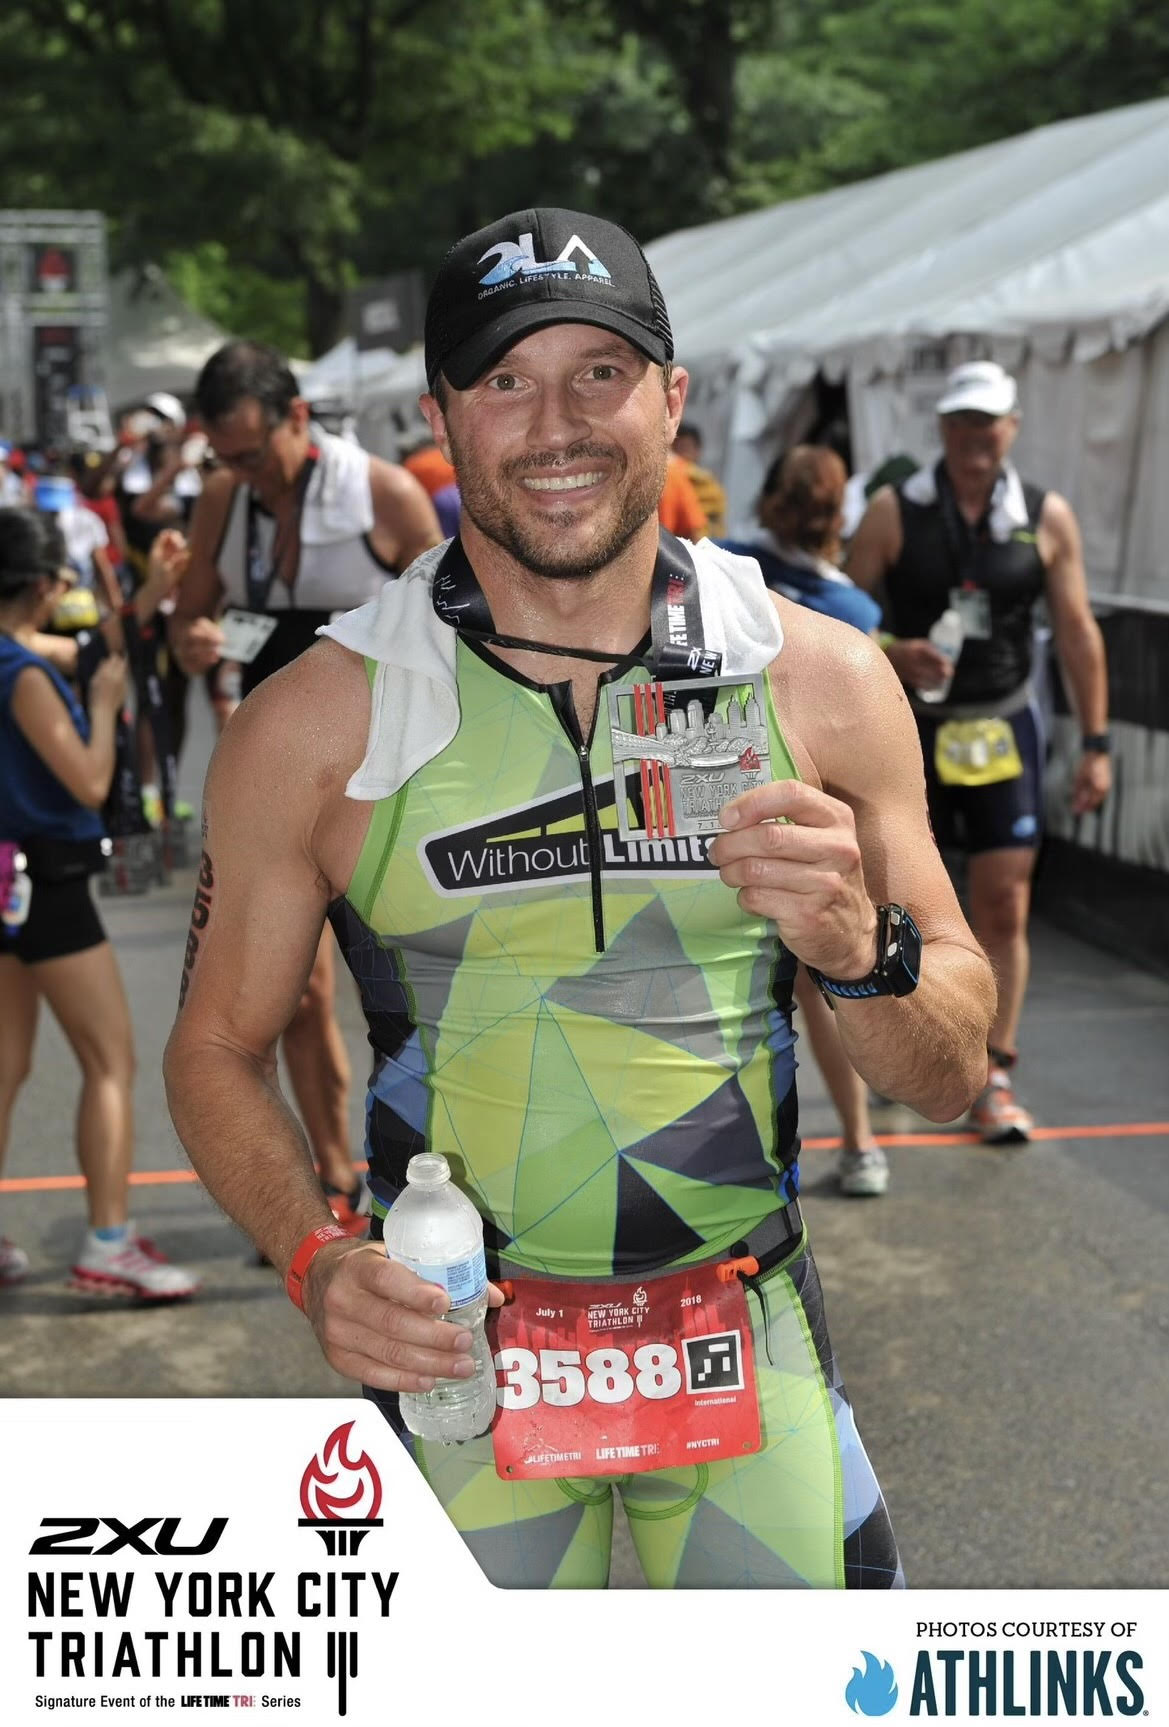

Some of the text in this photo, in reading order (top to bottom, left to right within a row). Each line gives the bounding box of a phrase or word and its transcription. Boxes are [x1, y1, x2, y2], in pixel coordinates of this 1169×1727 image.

[699, 650, 719, 675] NEW
[681, 771, 725, 785] 2XU
[682, 784, 705, 800] NEW
[709, 783, 737, 797] YORK
[448, 837, 590, 881] Without
[680, 1295, 702, 1307] 2018
[535, 1307, 564, 1319] July 1
[587, 1306, 650, 1320] NEW YORK CITY
[588, 1315, 634, 1329] TRIATHLON
[494, 1343, 683, 1411] 3588
[686, 1437, 720, 1449] #NYCTRI
